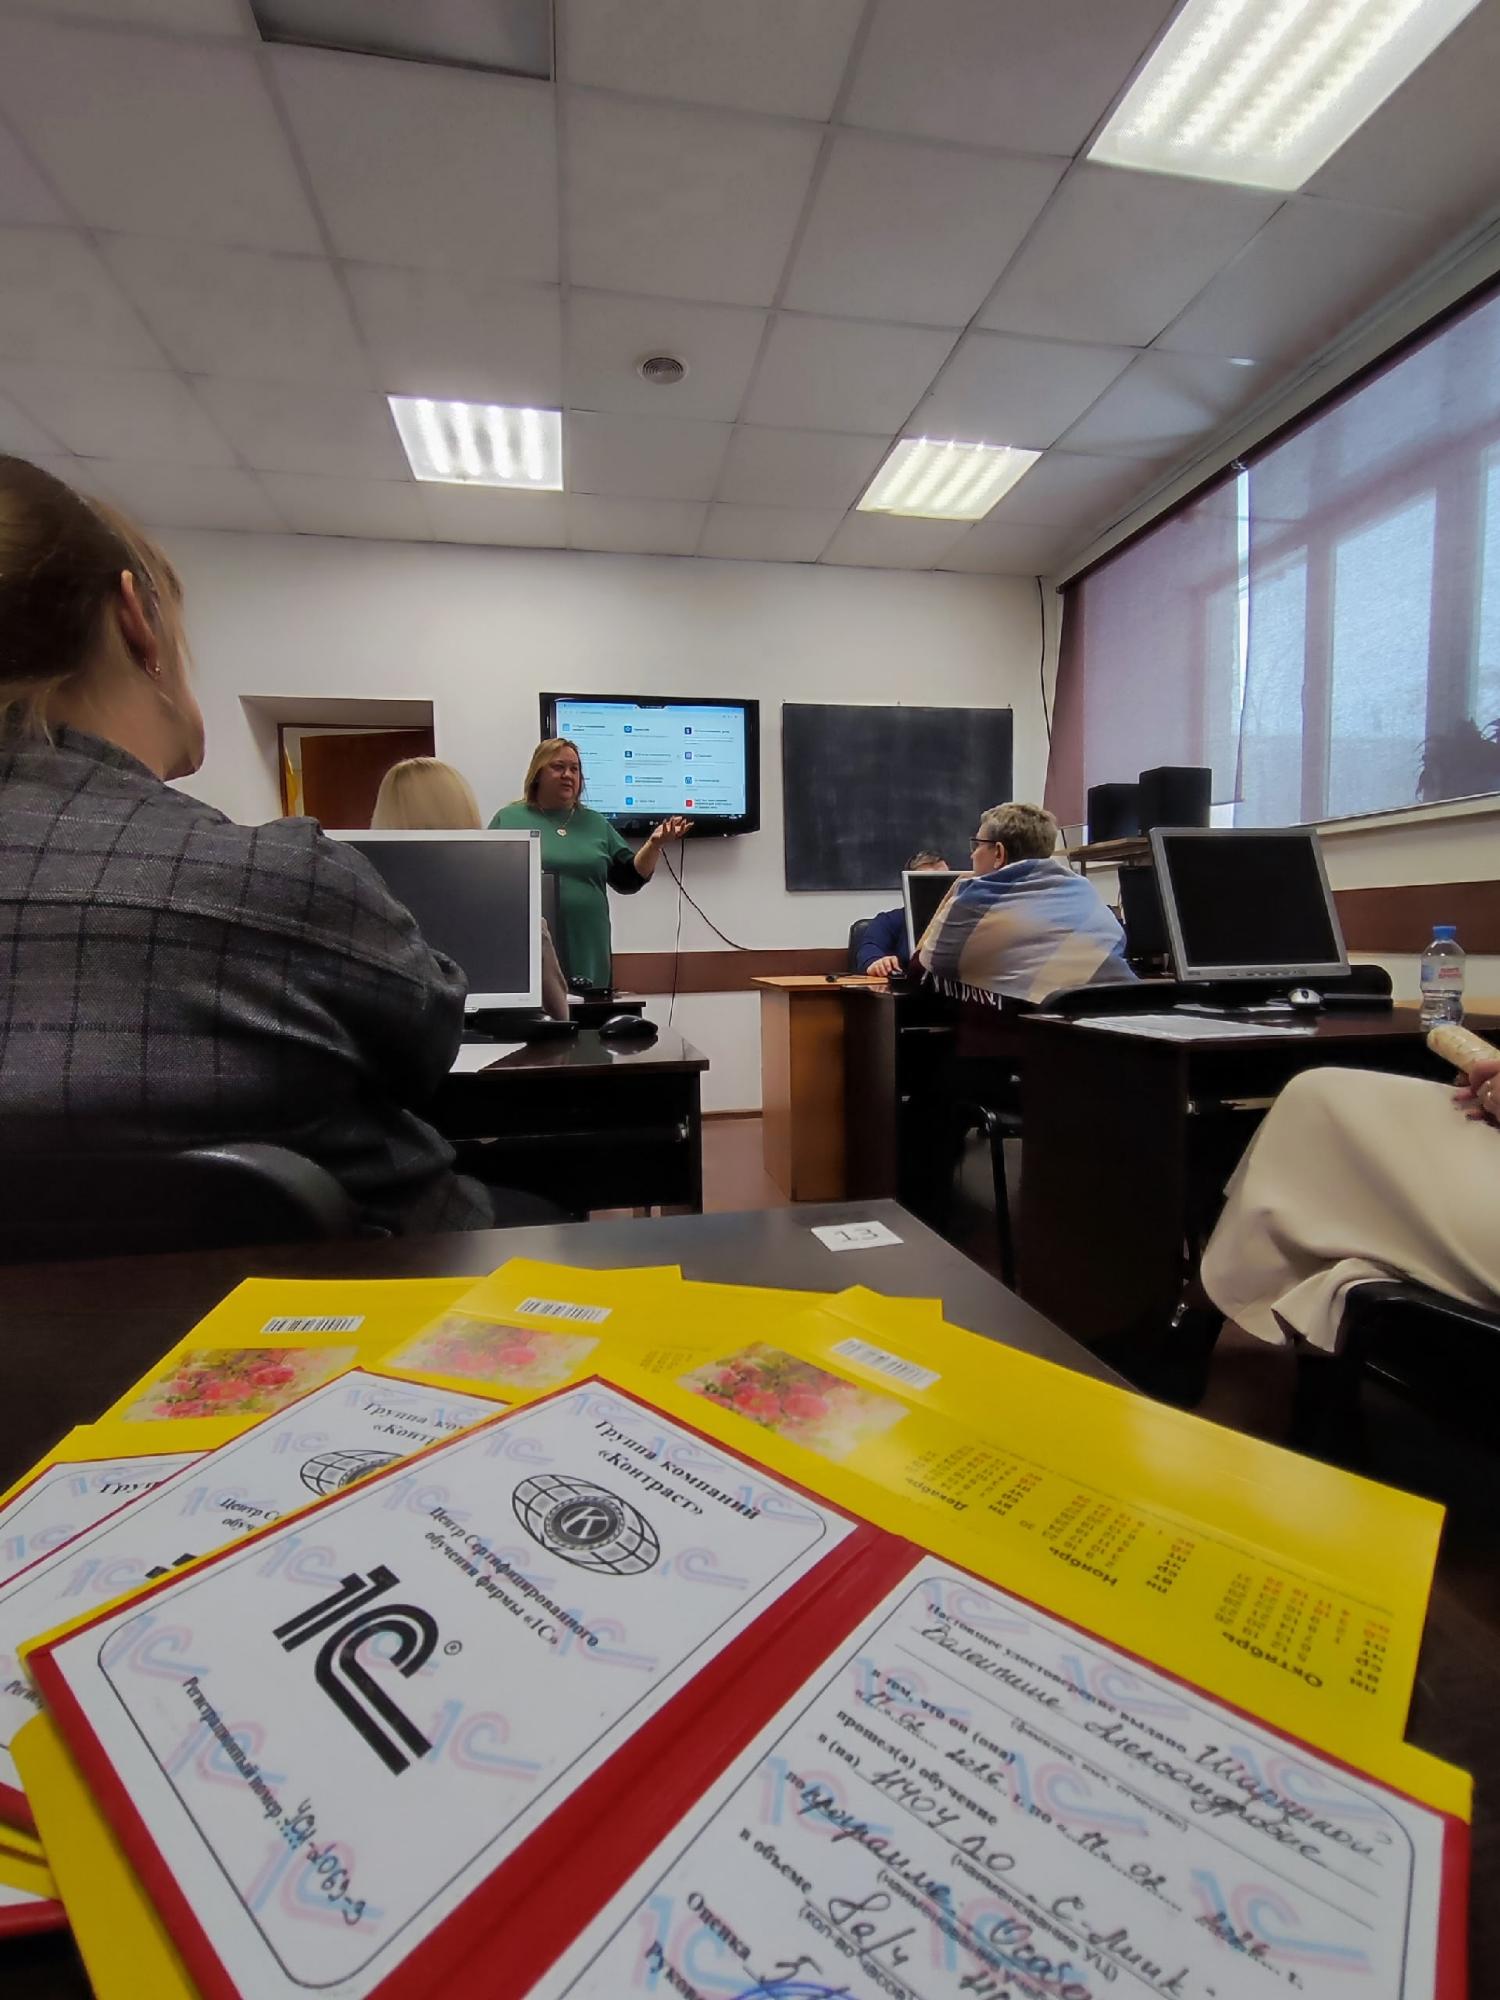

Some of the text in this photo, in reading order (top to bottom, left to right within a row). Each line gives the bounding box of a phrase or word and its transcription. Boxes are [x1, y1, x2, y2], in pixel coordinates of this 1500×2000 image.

[834, 1228, 879, 1242] 13
[362, 1402, 428, 1425] Группа
[594, 1420, 762, 1520] Группа компаний
[598, 1449, 704, 1516] «Контраст»
[219, 1497, 264, 1518] Центр
[425, 1531, 480, 1578] обучения
[475, 1574, 525, 1617] фирмы
[429, 1506, 599, 1647] Центр Сертифицированного
[1049, 1546, 1118, 1586] Ноябрь
[928, 1603, 1188, 1753] Настоящее удостоверение выдано
[1221, 1631, 1323, 1688] Октябрь
[183, 1676, 283, 1820] Регистрационный номер
[828, 1739, 861, 1768] (на)
[885, 1678, 914, 1703] том,
[919, 1699, 945, 1720] что
[948, 1717, 969, 1734] он
[971, 1732, 1016, 1765] (она)
[785, 1771, 806, 1790] по
[836, 1710, 998, 1827] прошел(а) обучение
[1028, 1803, 1053, 1824] по
[740, 1827, 813, 1894] в объеме
[687, 1892, 752, 1961] Оценка
